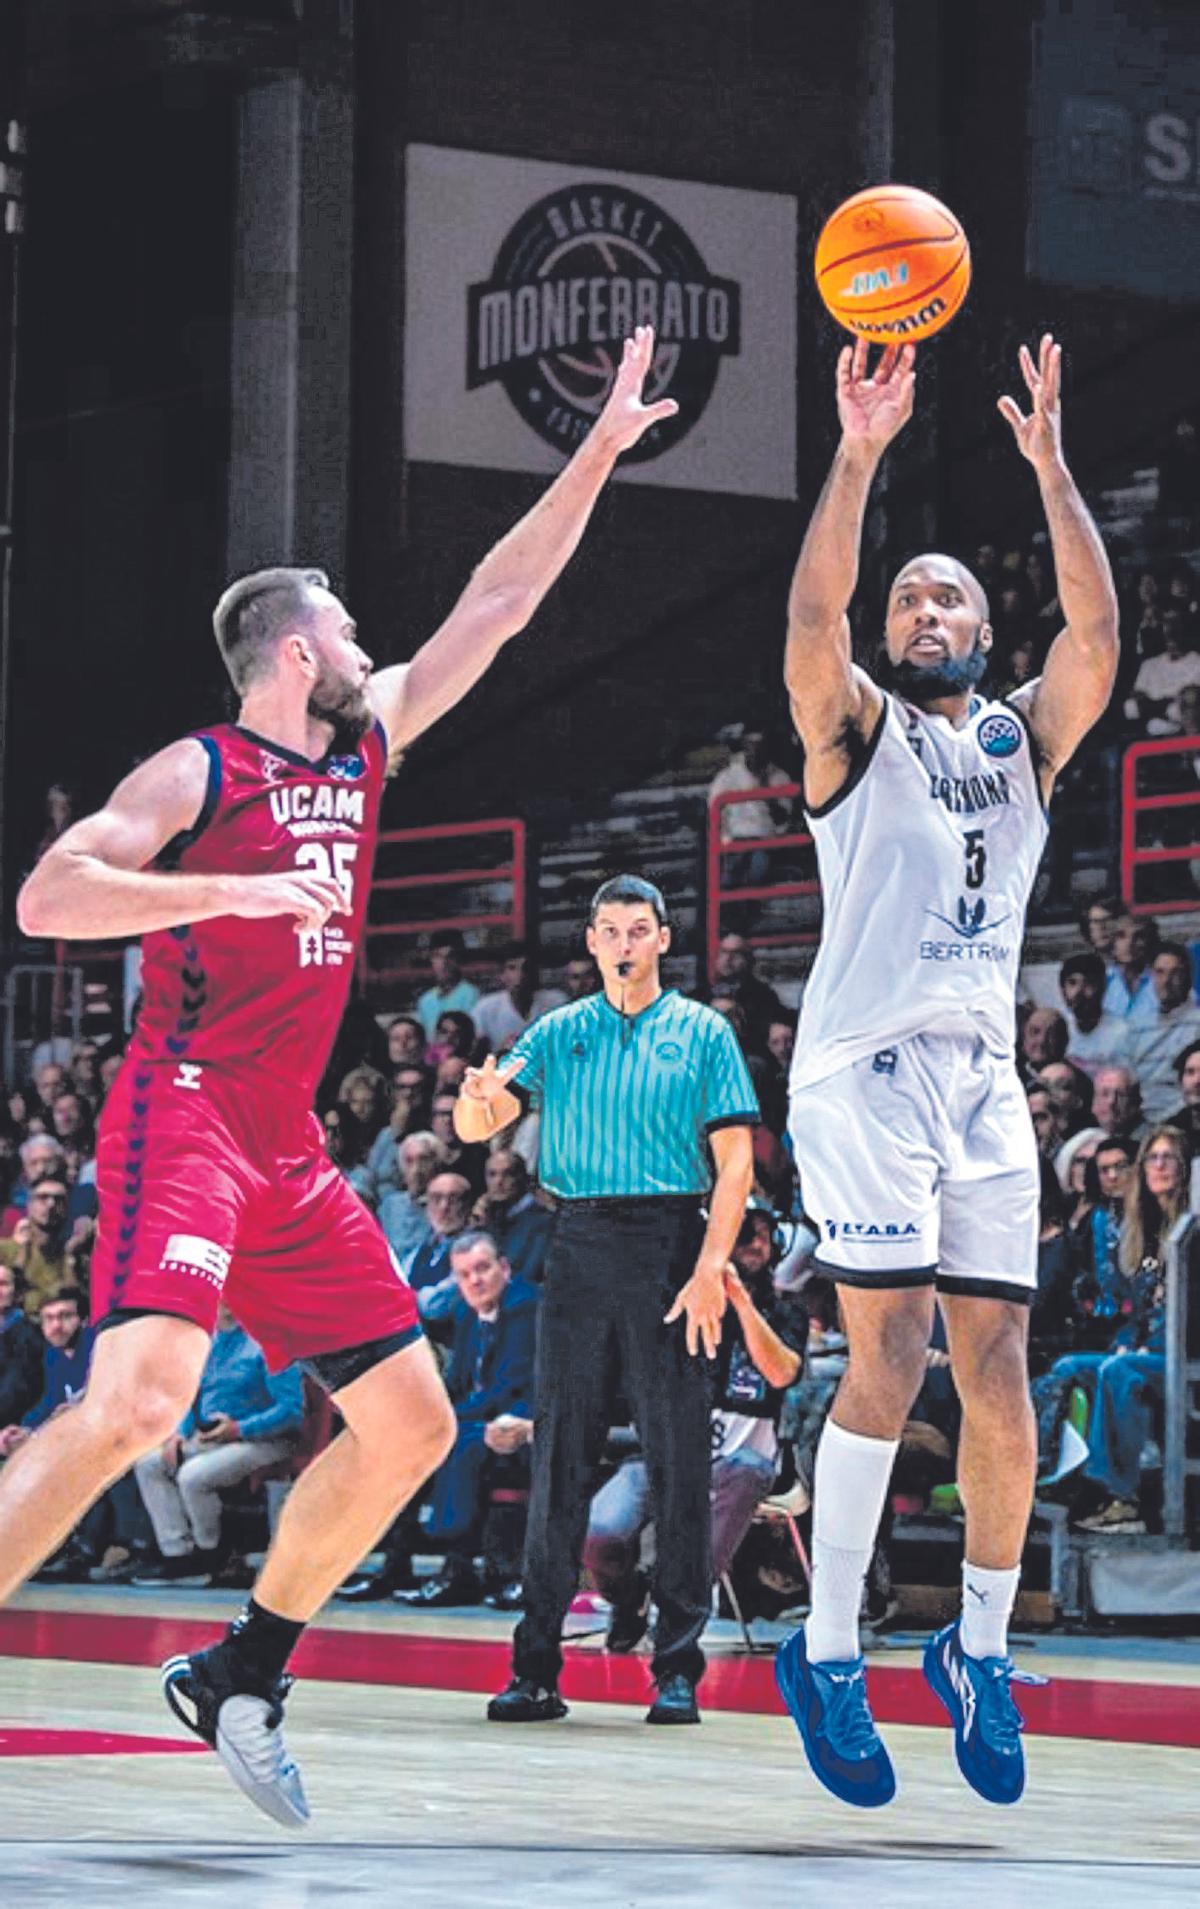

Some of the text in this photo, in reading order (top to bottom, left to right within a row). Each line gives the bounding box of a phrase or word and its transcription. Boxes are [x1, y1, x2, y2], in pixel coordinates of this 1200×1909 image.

[546, 196, 663, 248] BASKET
[478, 277, 729, 370] MONFERRATO
[270, 784, 365, 825] UCAM
[963, 830, 987, 888] 5
